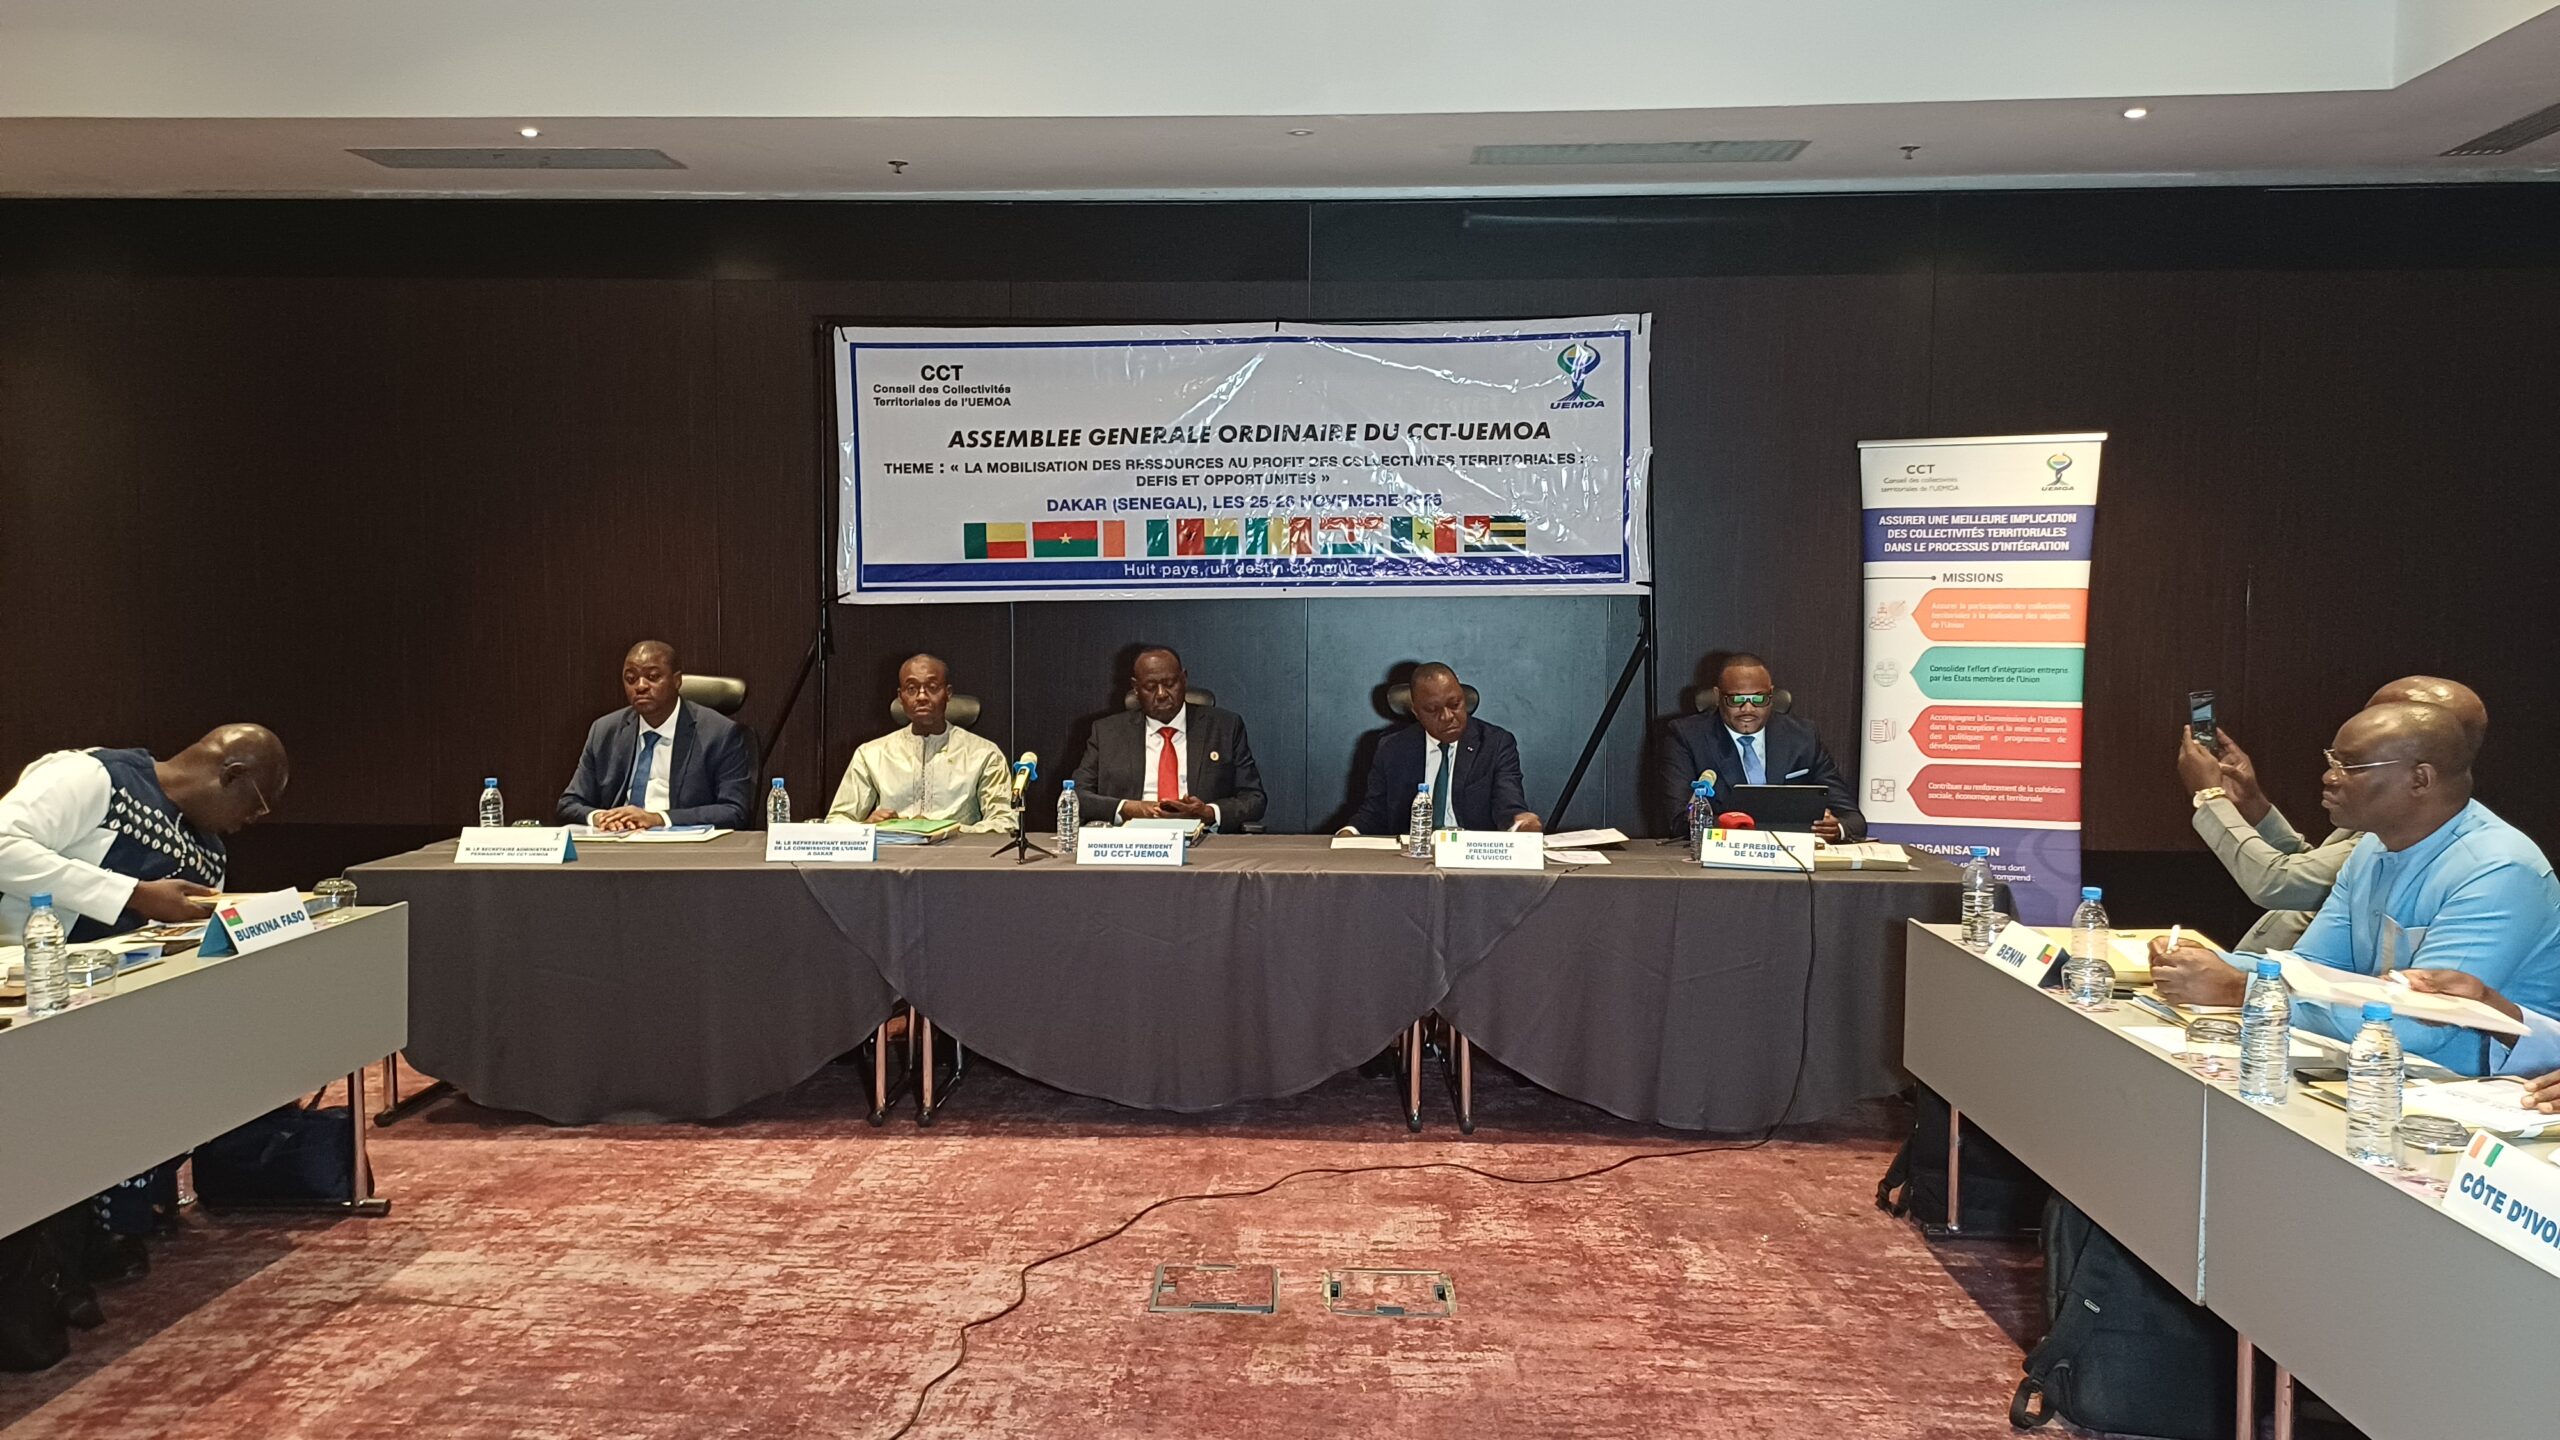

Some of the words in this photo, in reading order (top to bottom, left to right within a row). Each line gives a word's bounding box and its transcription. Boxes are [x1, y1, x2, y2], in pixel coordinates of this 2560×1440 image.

[921, 364, 964, 381] CCT
[873, 384, 915, 394] Conseil
[919, 384, 939, 394] des
[942, 384, 1011, 394] Collectivités
[873, 397, 941, 407] Territoriales
[944, 397, 958, 407] de
[961, 397, 1011, 407] l'UEMOA
[1550, 400, 1605, 409] UEMOA
[948, 429, 1082, 448] ASSEMBLEE
[1088, 426, 1211, 446] GENERALE
[1218, 424, 1357, 443] ORDINAIRE
[1364, 423, 1400, 442] DU
[1407, 421, 1550, 442] CCT-UEMOA
[884, 462, 934, 474] THEME
[939, 462, 945, 474] :
[965, 462, 983, 474] LA
[987, 460, 1088, 473] MOBILISATION
[1093, 459, 1122, 471] DES
[1126, 457, 1224, 470] RESSOURCES
[1229, 457, 1248, 469] AU
[1253, 456, 1305, 469] PROFIT
[1459, 453, 1577, 466] TERRITORIALES
[1906, 464, 1936, 475] CCT
[1137, 474, 1178, 487] DEFIS
[1182, 474, 1200, 486] ET
[1204, 472, 1317, 486] OPPORTUNITES
[1047, 499, 1107, 512] DAKAR
[1113, 496, 1207, 513] (SENEGAL),
[1213, 495, 1245, 509] LES
[1300, 493, 1399, 508] NOVEMBRE
[1879, 515, 1926, 525] ASSURER
[1928, 515, 1948, 525] UNE
[1951, 514, 2007, 524] MEILLEURE
[2010, 513, 2077, 523] IMPLICATION
[1887, 529, 1907, 539] DES
[1909, 526, 1985, 538] COLLECTIVITÉS
[1987, 527, 2067, 537] TERRITORIALES
[1884, 542, 1912, 552] DANS
[1914, 542, 1926, 552] LE
[1929, 541, 1989, 552] PROCESSUS
[1991, 539, 2070, 551] D'INTÉGRATION
[1124, 563, 1156, 576] Huit
[1162, 563, 1204, 578] pays,
[1211, 564, 1229, 575] un
[1235, 562, 1284, 576] destin
[1942, 573, 2004, 583] MISSIONS
[1930, 665, 1965, 673] Consolider
[1967, 665, 1990, 673] l'effort
[1992, 666, 2036, 674] d'intégration
[2038, 667, 2069, 675] entrepris
[1930, 675, 1941, 683] par
[1973, 675, 2005, 683] membres
[2006, 675, 2015, 683] de
[2016, 675, 2041, 683] l'Union
[1930, 714, 1976, 723] Accompagner
[1985, 714, 2027, 723] Commission
[2028, 715, 2037, 723] de
[1929, 733, 1943, 741] des
[1948, 733, 1985, 743] politiques
[1990, 734, 1999, 742] et
[2004, 734, 2051, 744] programmes
[2057, 735, 2067, 743] de
[1929, 742, 1981, 751] développement
[1928, 782, 1963, 791] Contribuer
[1973, 783, 2017, 792] renforcement
[2018, 784, 2027, 792] de
[2027, 785, 2034, 793] la
[2035, 785, 2066, 794] cohésion
[1955, 792, 1997, 802] économique
[1998, 793, 2006, 802] et
[2006, 793, 2043, 803] territoriale
[1093, 850, 1108, 858] DU
[1110, 850, 1170, 858] CCT-UEMOA
[1749, 851, 1776, 859] L'ADS
[2008, 864, 2027, 873] dont
[234, 918, 281, 942] BURKINA
[280, 910, 305, 927] FASO
[1996, 943, 2027, 968] BENIN
[2460, 1172, 2507, 1214] CÔTE
